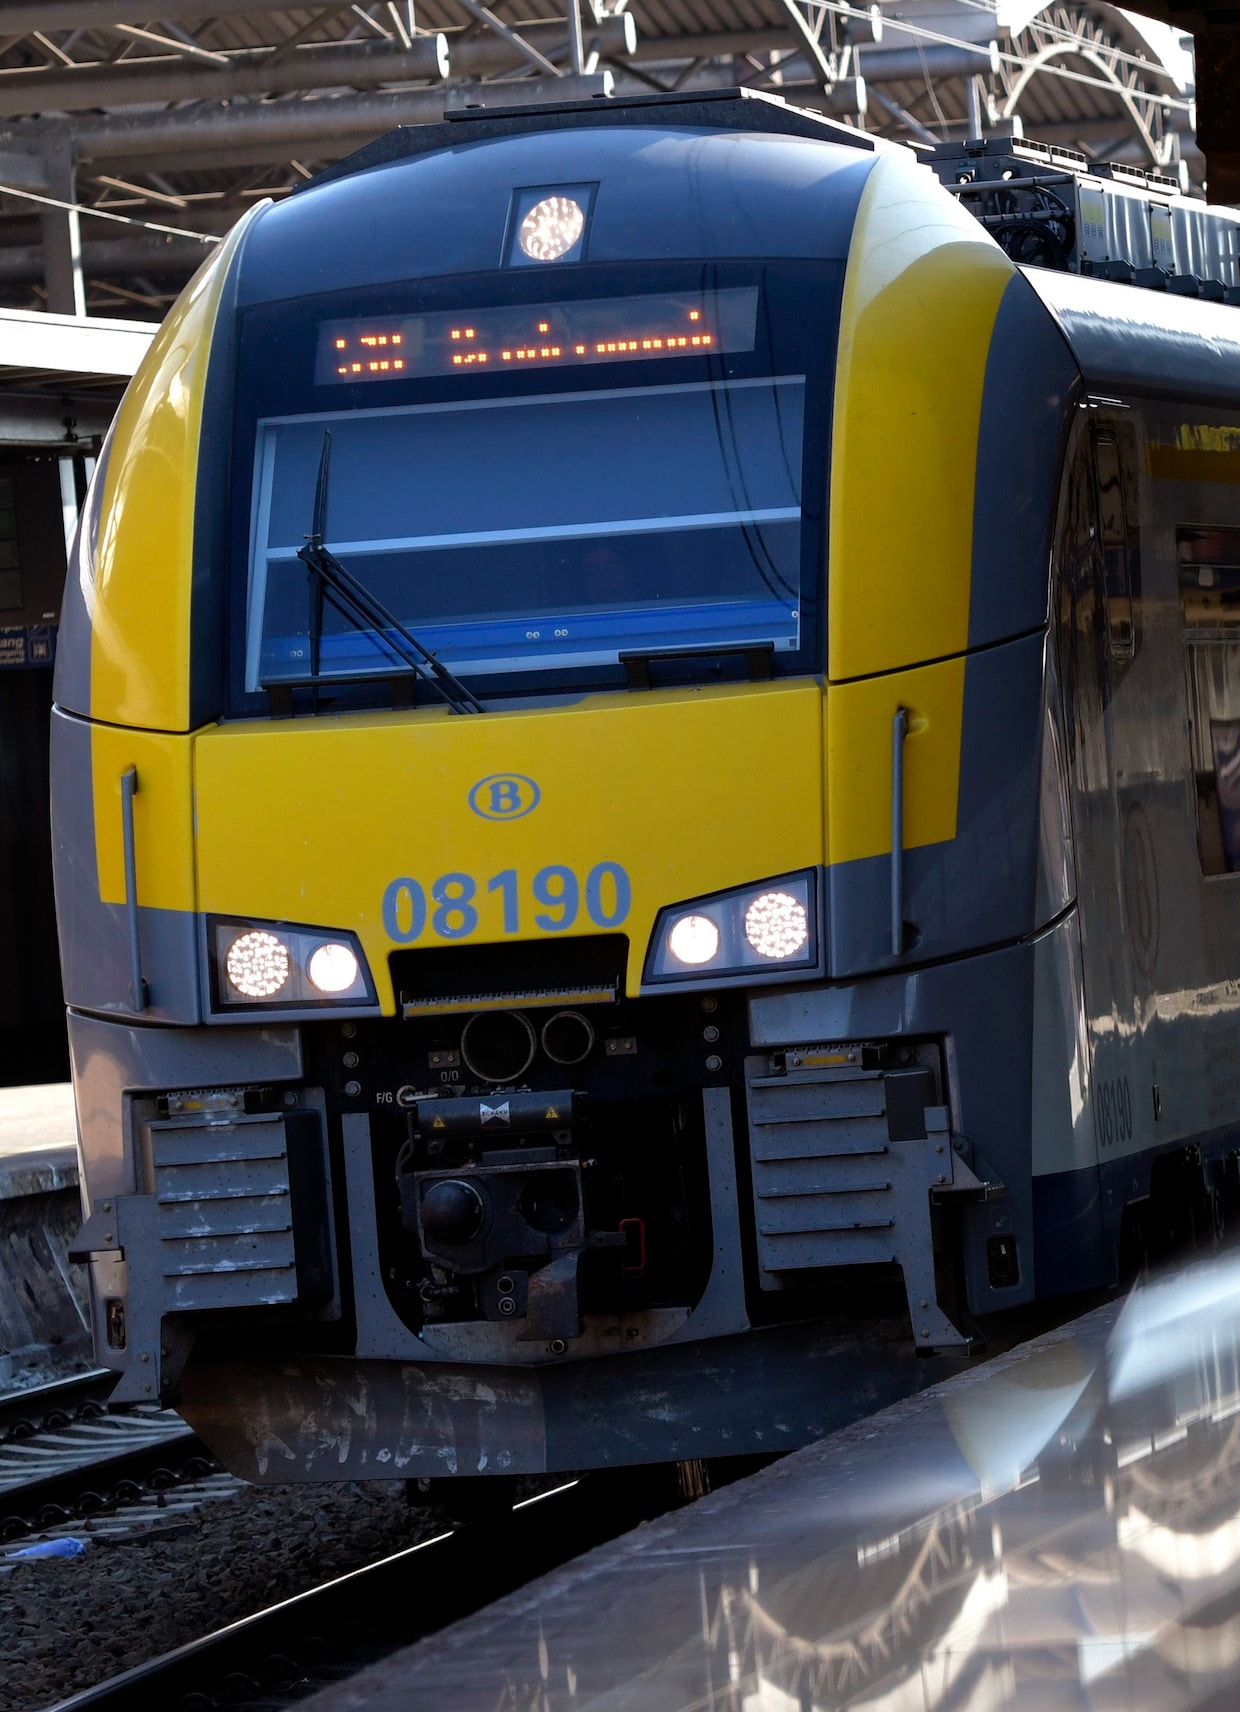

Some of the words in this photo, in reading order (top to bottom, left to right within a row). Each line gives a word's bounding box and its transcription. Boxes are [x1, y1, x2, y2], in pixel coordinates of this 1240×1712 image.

[382, 861, 632, 944] 08190
[376, 1091, 394, 1104] F/G
[1096, 1075, 1132, 1148] 08190
